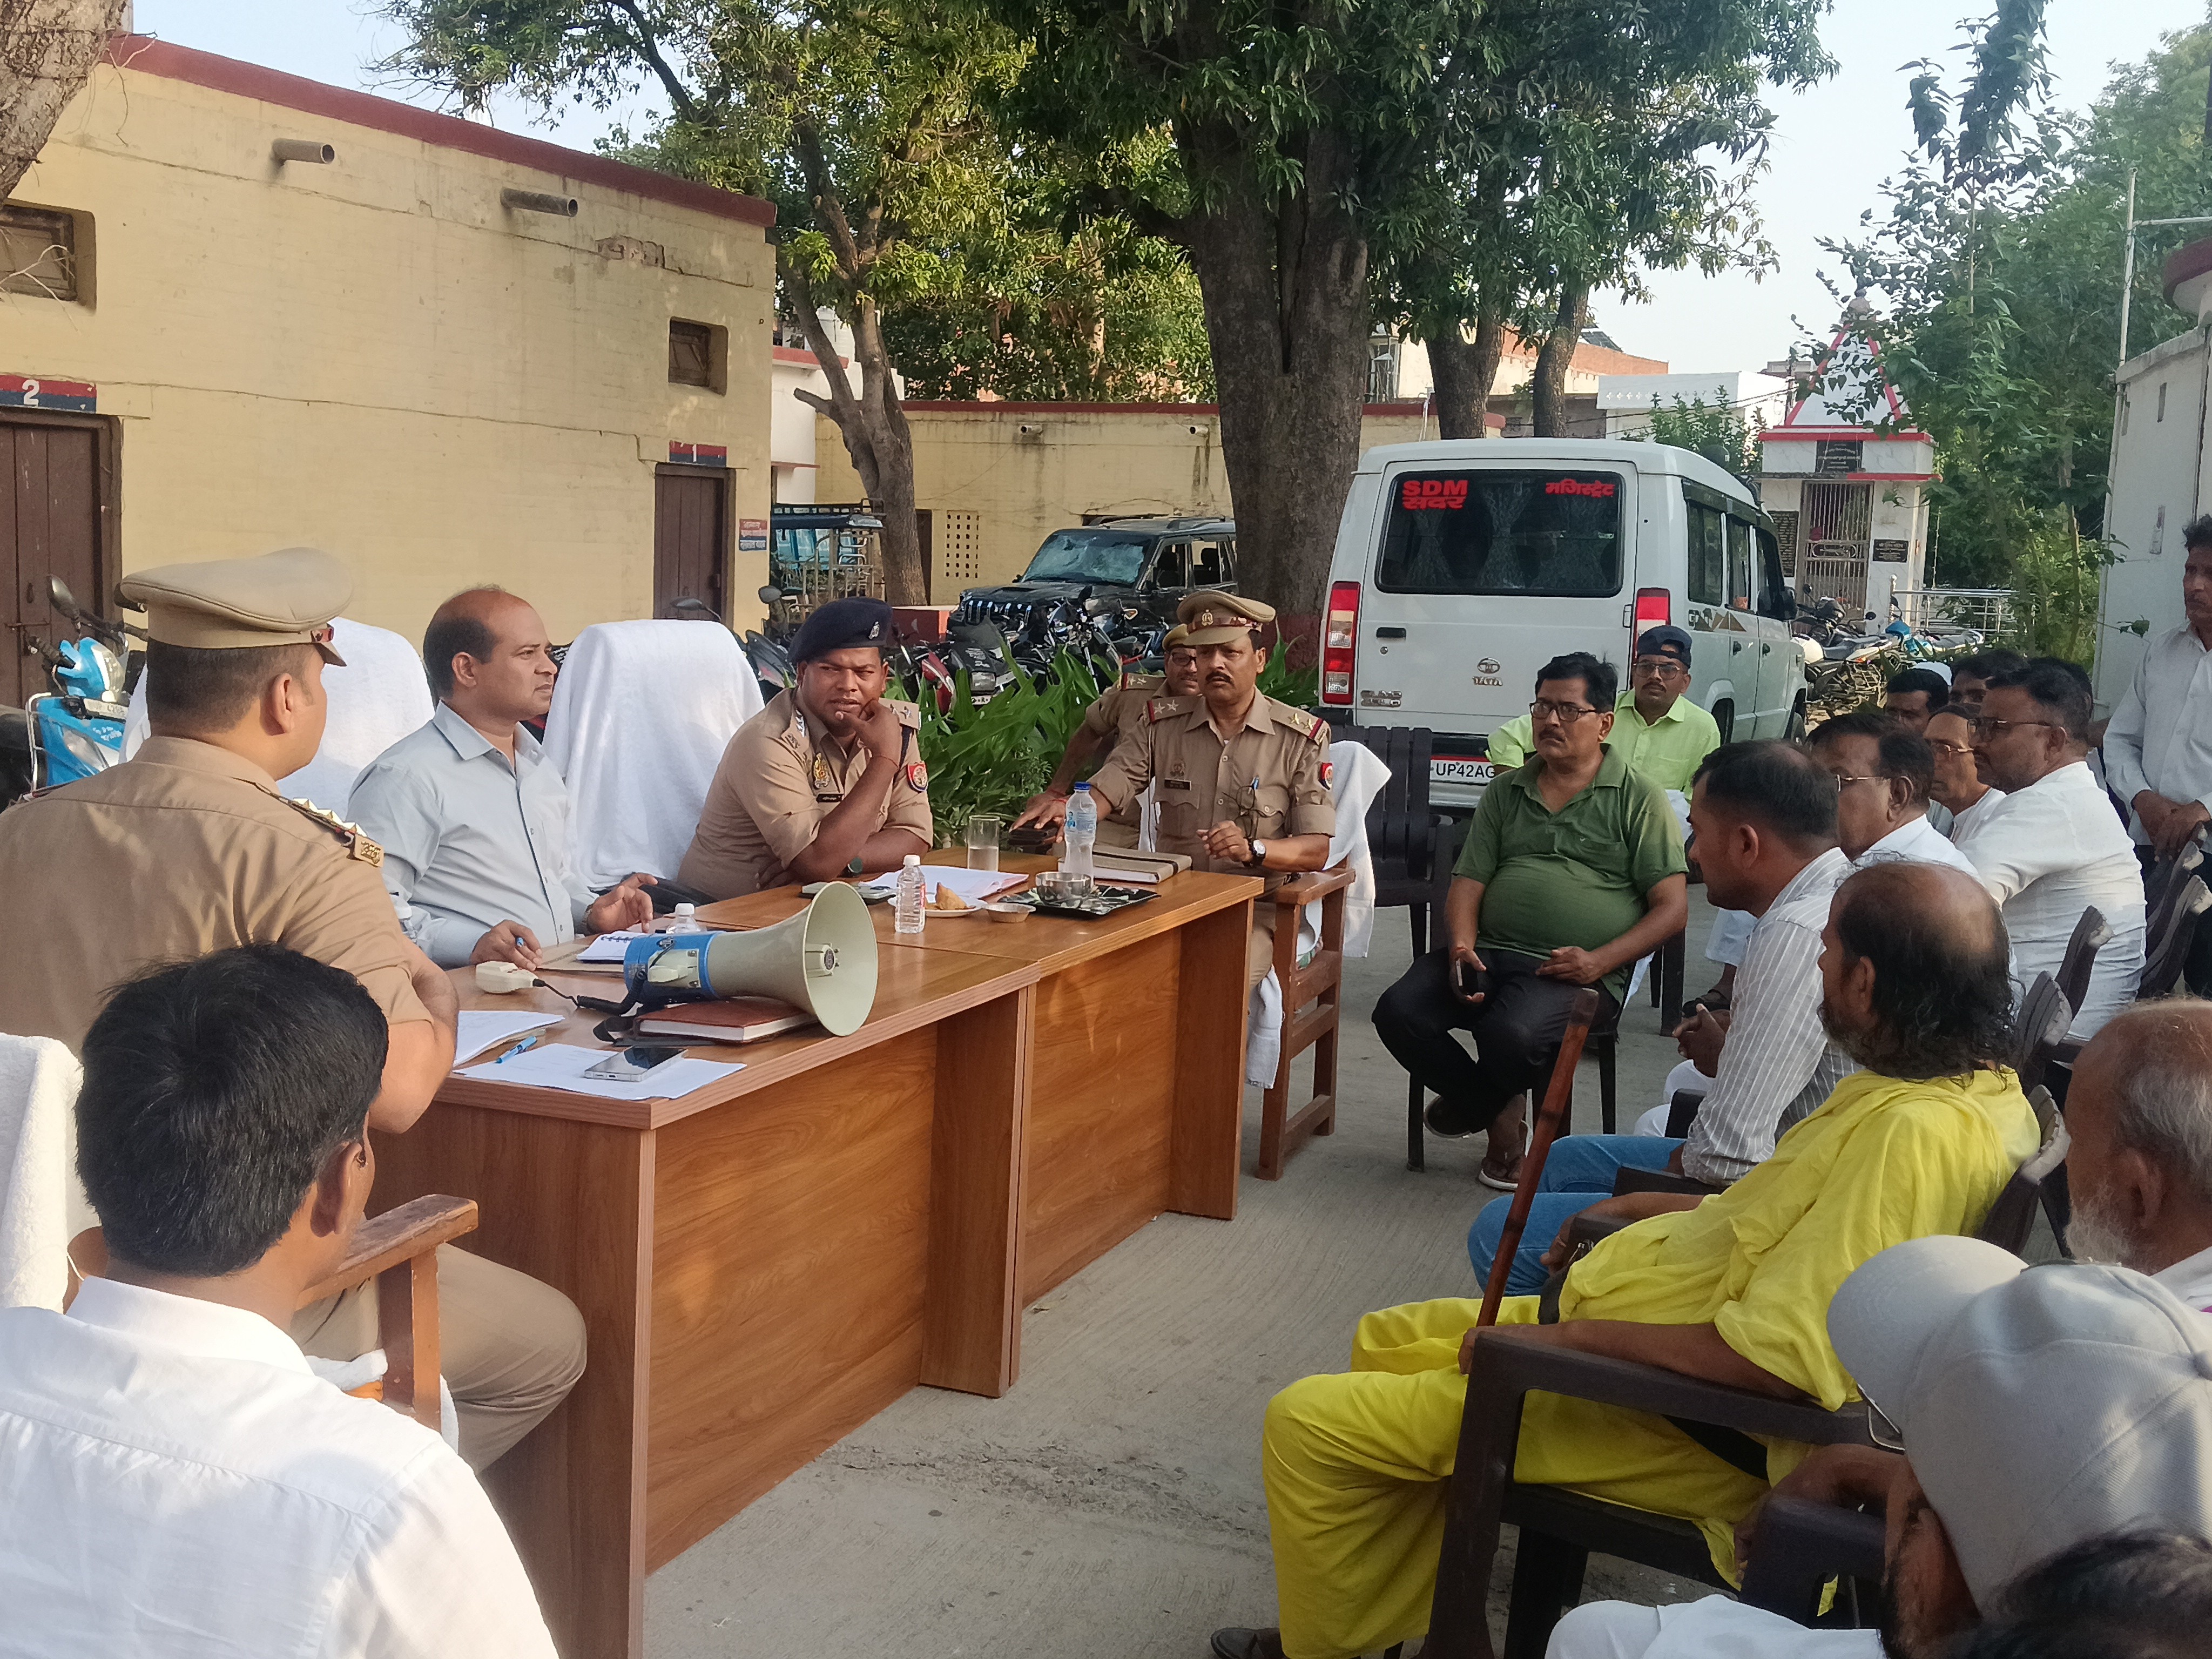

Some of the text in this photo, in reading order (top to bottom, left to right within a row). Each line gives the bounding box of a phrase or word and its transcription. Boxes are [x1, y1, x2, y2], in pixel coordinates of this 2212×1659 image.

[22, 379, 40, 406] 2
[692, 444, 697, 462] 1
[1402, 480, 1468, 496] SDM
[1546, 478, 1615, 497] मजिस्ट्रेट
[1402, 496, 1466, 510] सदर
[1437, 763, 1495, 778] UP42AG
